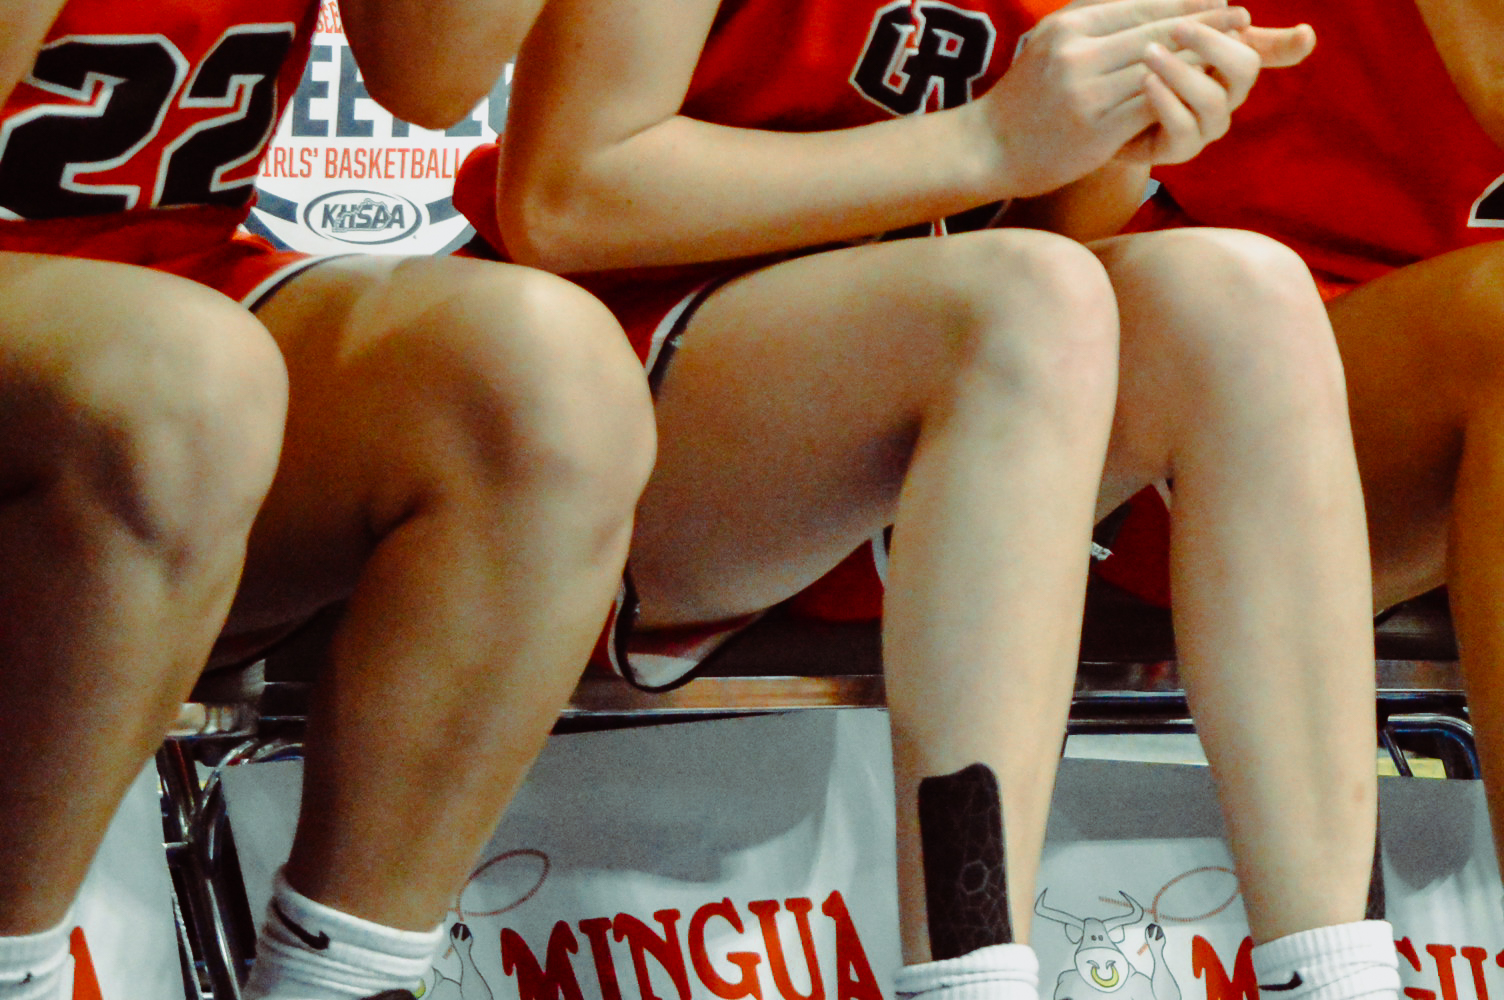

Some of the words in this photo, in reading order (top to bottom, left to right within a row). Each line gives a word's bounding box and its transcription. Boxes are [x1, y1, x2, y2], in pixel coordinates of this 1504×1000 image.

[0, 21, 296, 221] 22
[262, 147, 319, 179] IRLS'
[321, 203, 406, 230] KHSAA
[500, 890, 885, 1000] MINGUA
